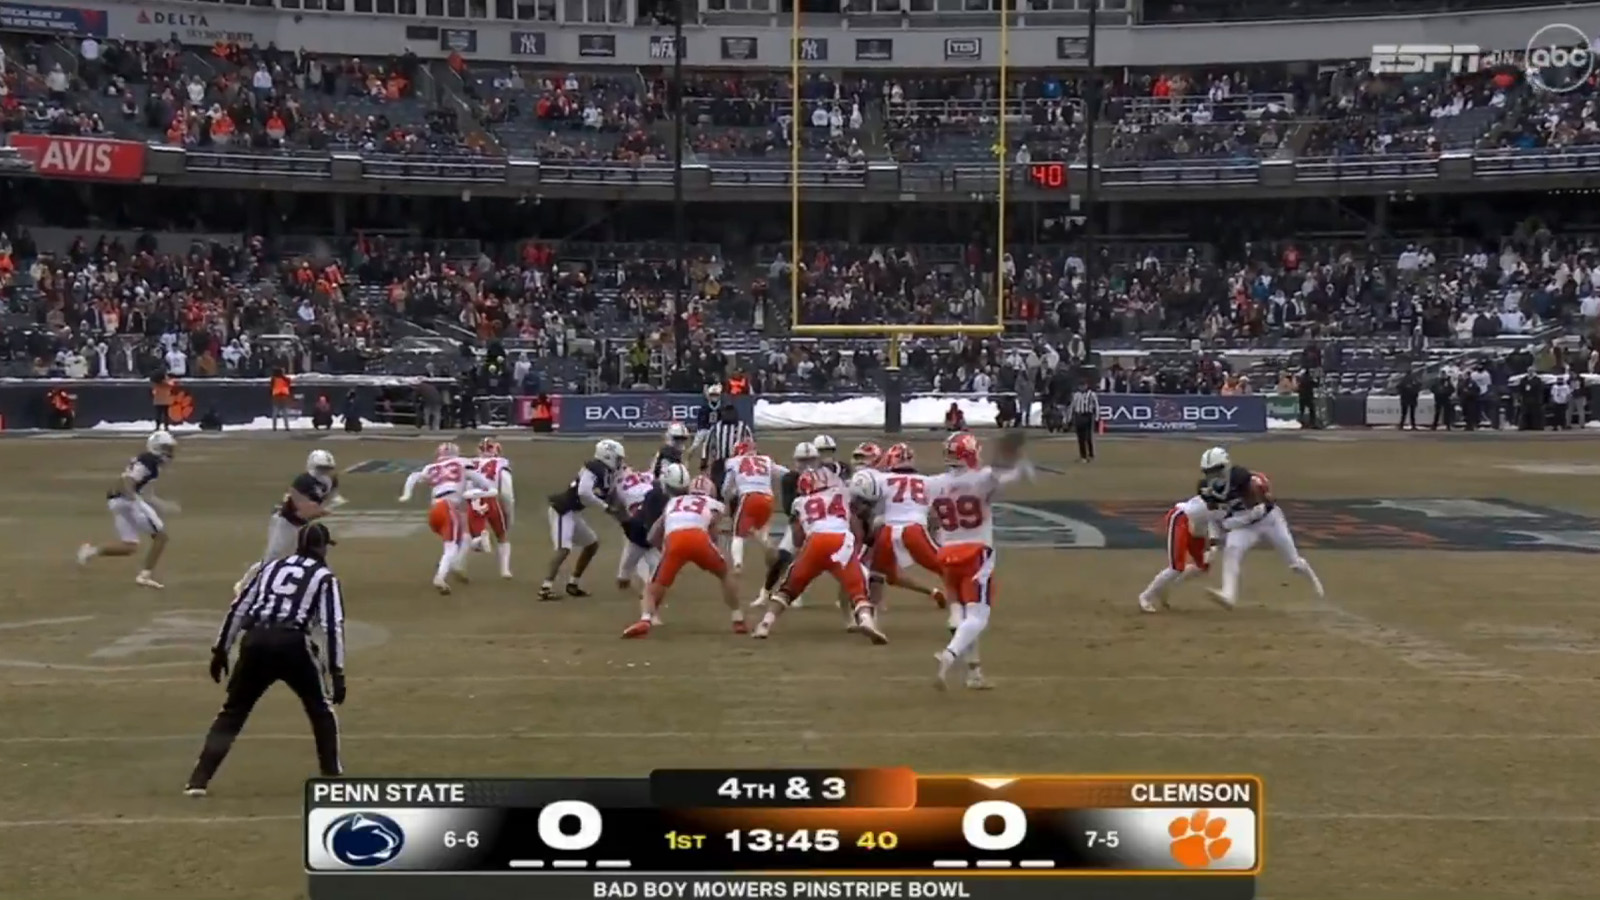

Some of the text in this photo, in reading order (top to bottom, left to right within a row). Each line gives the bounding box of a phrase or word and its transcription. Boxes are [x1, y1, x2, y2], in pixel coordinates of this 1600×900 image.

[154, 11, 209, 27] DELTA
[40, 141, 113, 173] AVIS
[1032, 164, 1062, 186] 40
[585, 405, 641, 420] BAD
[1182, 405, 1239, 420] BOY
[1138, 421, 1198, 430] MOWERS
[739, 456, 770, 477] 45
[669, 494, 707, 515] 13
[804, 494, 848, 523] 94
[932, 494, 983, 532] 99
[271, 565, 305, 595] C
